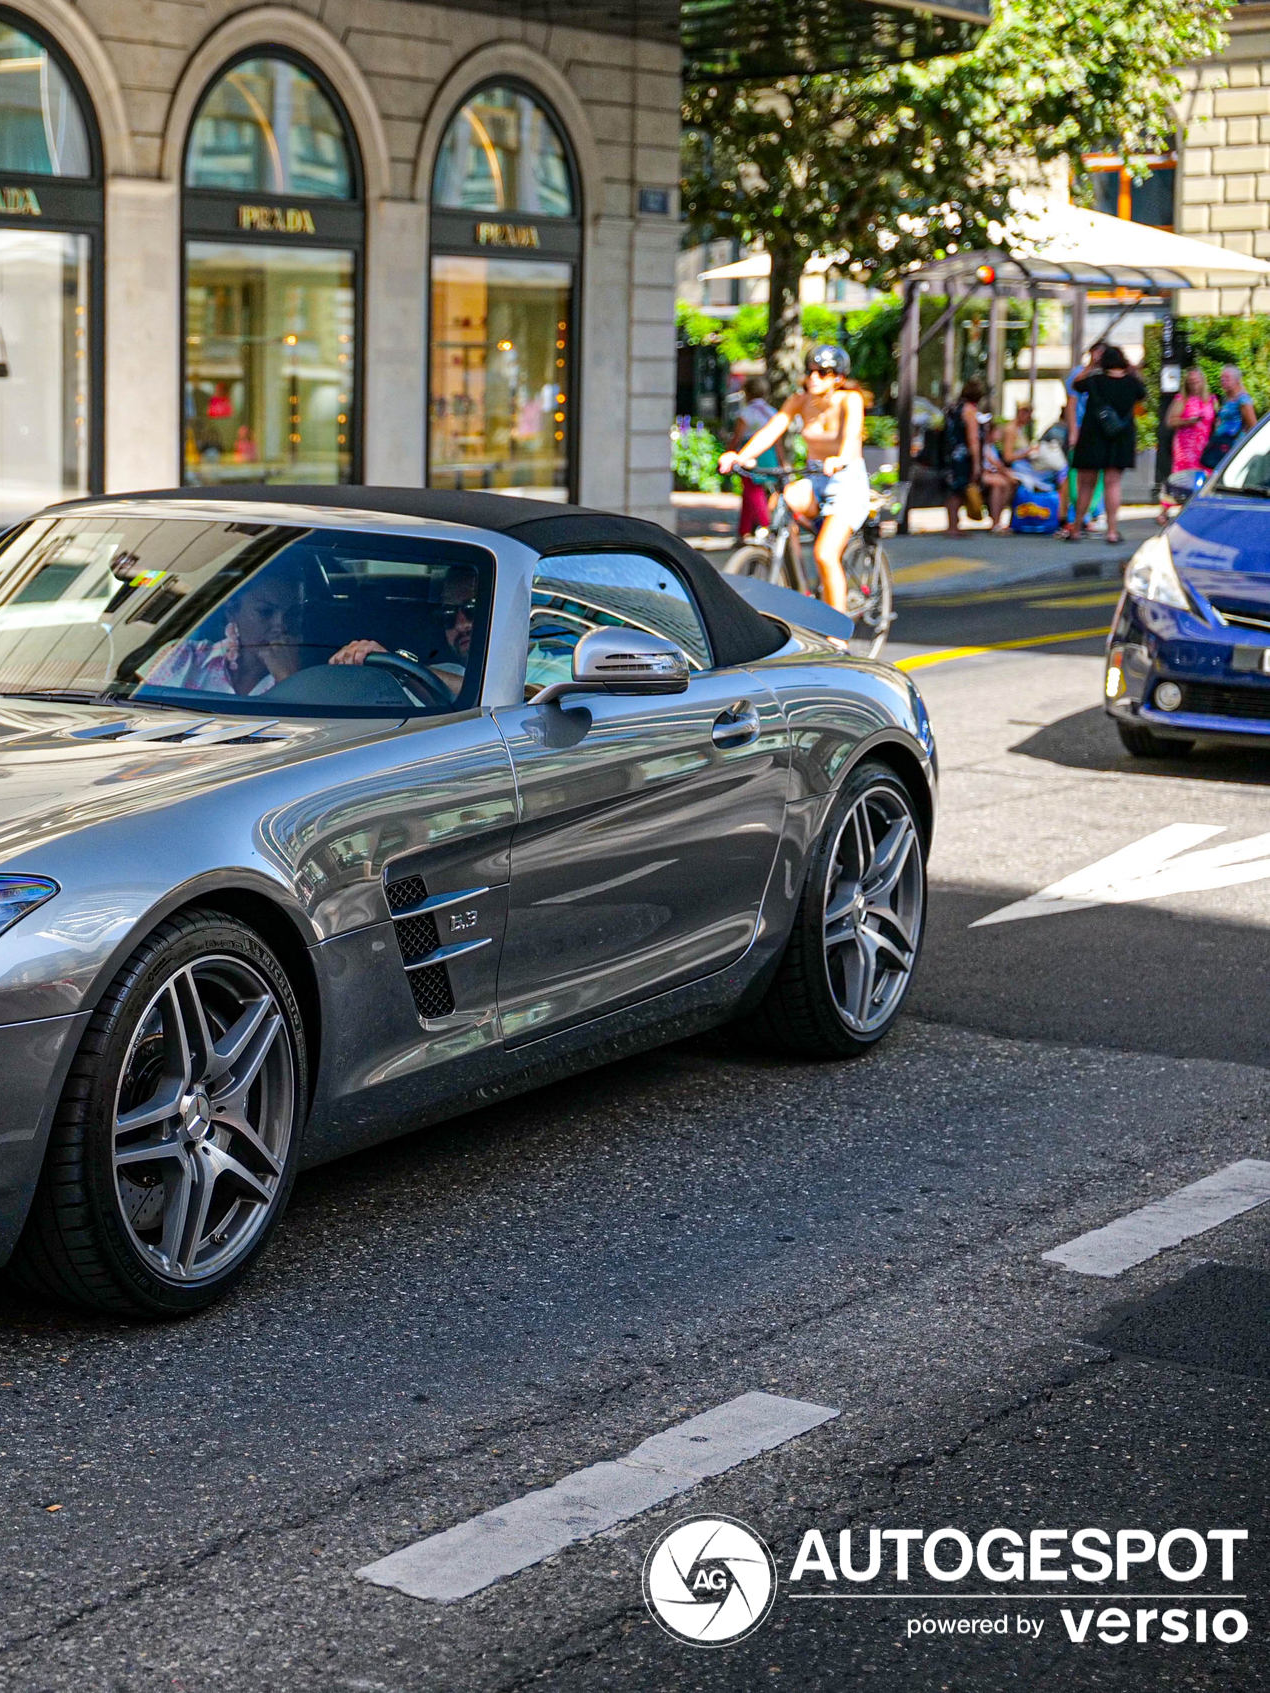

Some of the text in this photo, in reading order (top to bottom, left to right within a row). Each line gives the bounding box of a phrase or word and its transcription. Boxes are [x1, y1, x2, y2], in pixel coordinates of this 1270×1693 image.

[238, 204, 316, 235] PRADA
[475, 221, 541, 249] PRADA
[450, 910, 478, 932] 6.3
[260, 951, 301, 1027] MICHELIN
